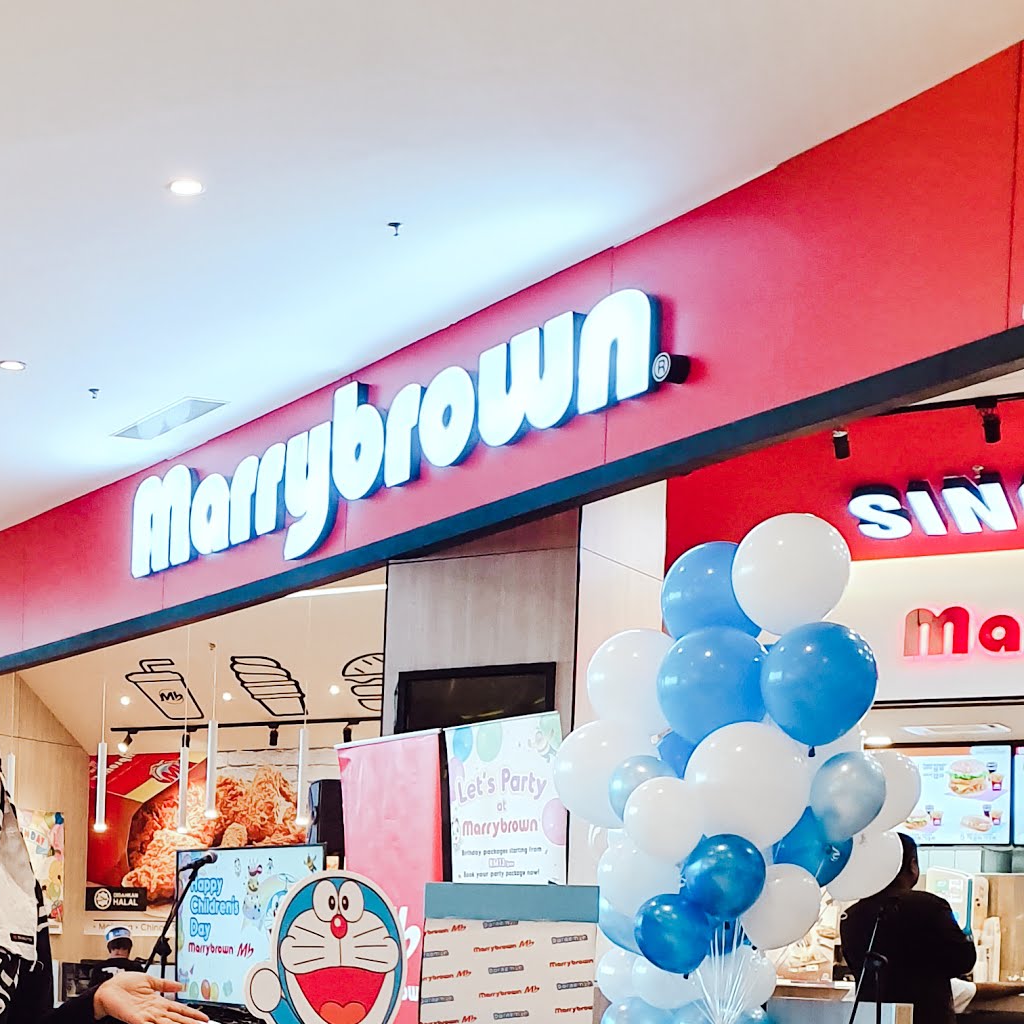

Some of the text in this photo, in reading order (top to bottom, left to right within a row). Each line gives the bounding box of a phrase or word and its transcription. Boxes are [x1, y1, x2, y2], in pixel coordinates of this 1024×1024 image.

[131, 288, 653, 579] Marrybrown
[848, 482, 1024, 540] SIN
[160, 691, 183, 702] Mb
[458, 768, 547, 803] Let's Party
[496, 801, 507, 812] at
[462, 818, 538, 837] Marrybrown
[112, 898, 139, 906] HALAL
[189, 895, 240, 916] Children's
[189, 917, 212, 941] Day
[188, 942, 234, 956] Marrybrown
